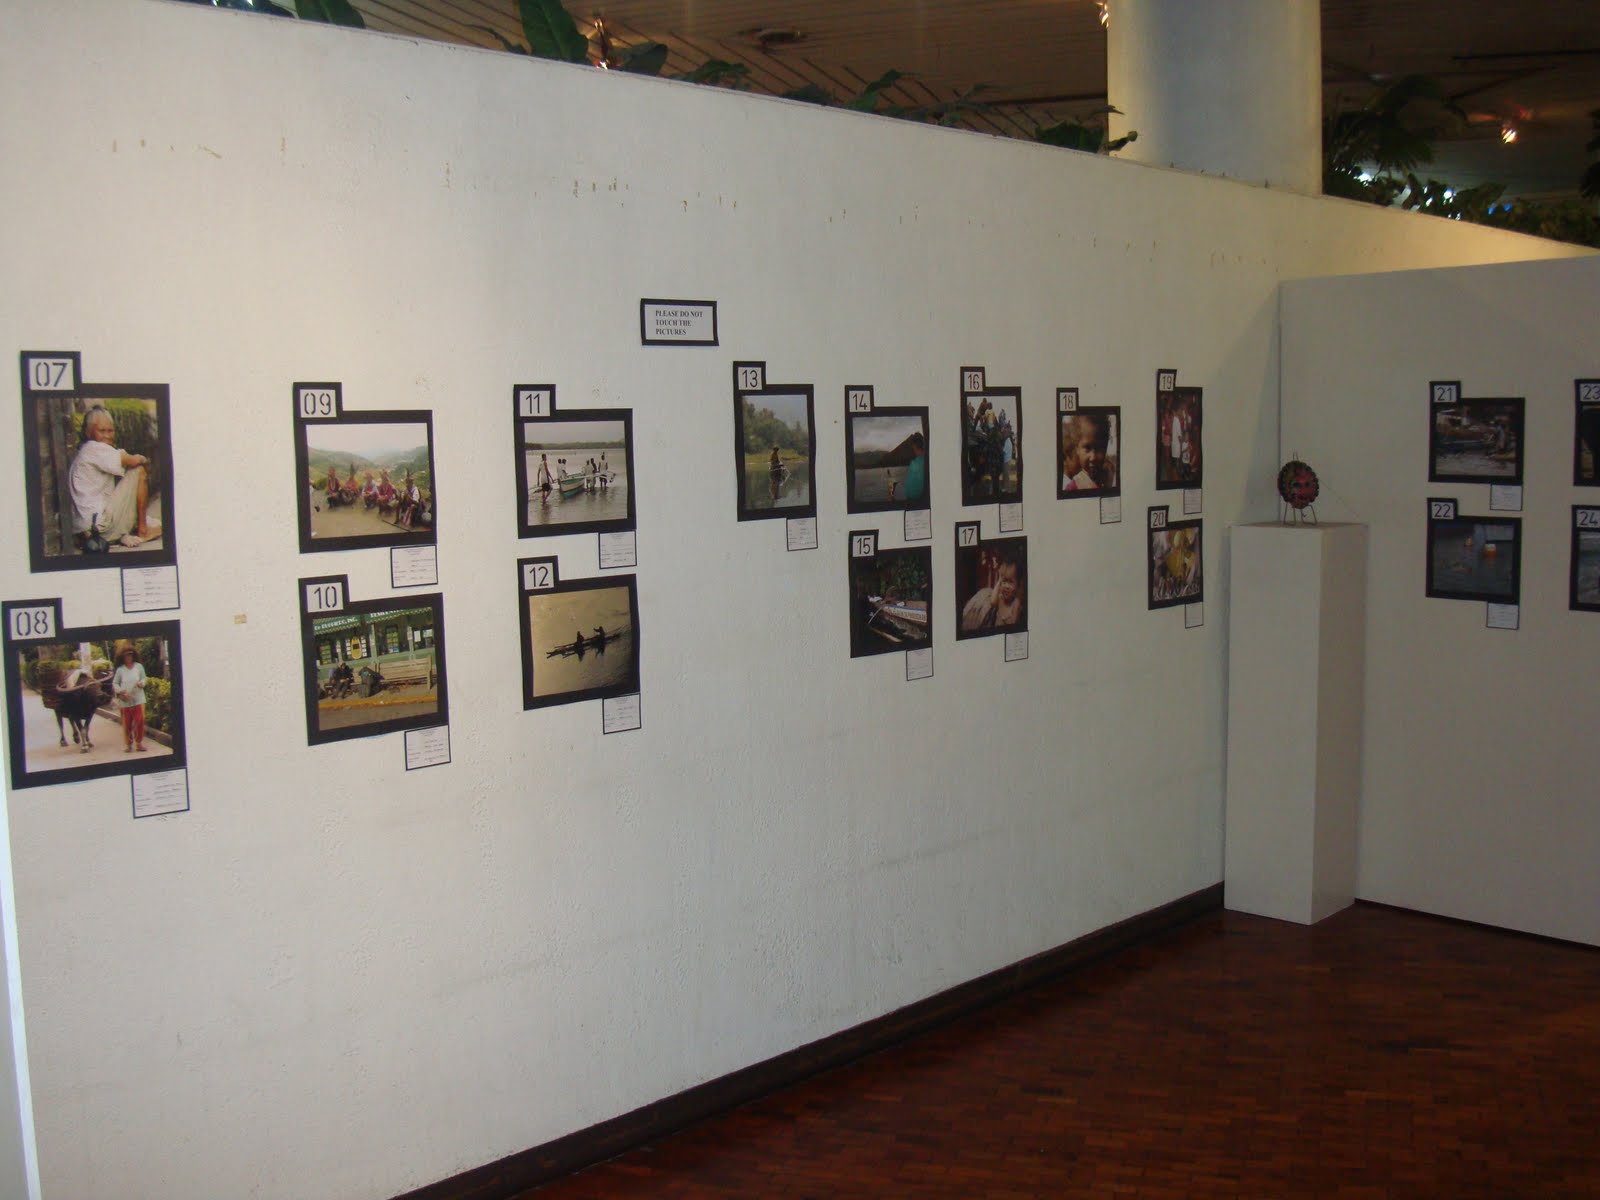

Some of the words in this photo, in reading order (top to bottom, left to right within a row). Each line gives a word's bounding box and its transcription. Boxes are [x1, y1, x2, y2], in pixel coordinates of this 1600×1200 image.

[36, 362, 67, 387] 07
[742, 370, 758, 388] 13
[968, 374, 979, 390] 16
[1163, 376, 1172, 389] 19
[853, 394, 867, 410] 14
[1063, 394, 1073, 409] 18
[1437, 387, 1452, 401] 21
[304, 393, 331, 415] 09
[526, 394, 540, 414] 11
[1153, 512, 1164, 526] 20
[1434, 504, 1450, 518] 22
[1580, 511, 1598, 526] 24
[963, 528, 974, 544] 17
[857, 538, 870, 554] 15
[530, 566, 548, 587] 12
[314, 586, 337, 609] 10
[16, 611, 48, 636] 08
